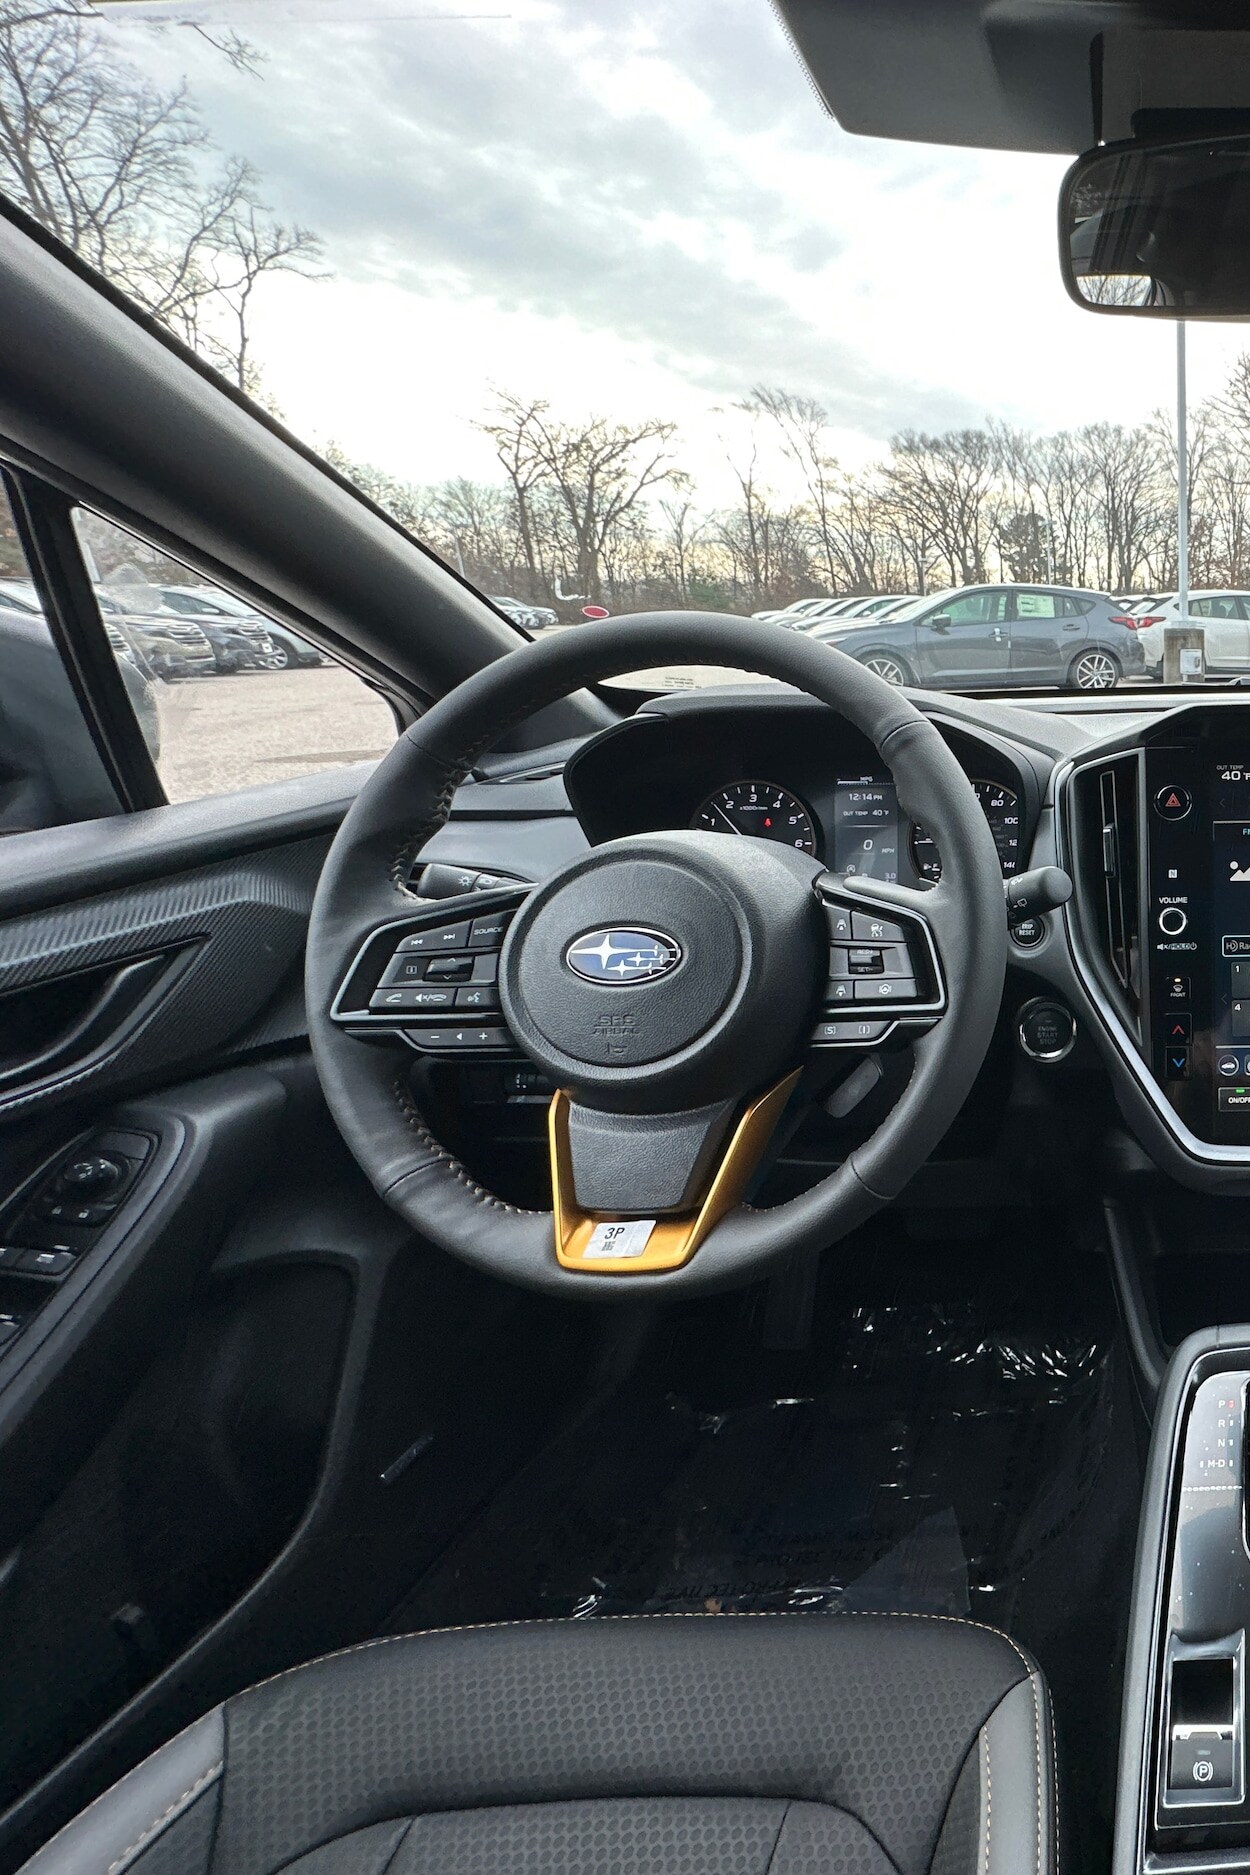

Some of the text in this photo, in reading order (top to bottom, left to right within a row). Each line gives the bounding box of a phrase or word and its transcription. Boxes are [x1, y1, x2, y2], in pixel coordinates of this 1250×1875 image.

[1221, 771, 1241, 780] 40
[863, 840, 873, 850] 0
[604, 1228, 625, 1239] 3P
[1218, 1439, 1225, 1447] N
